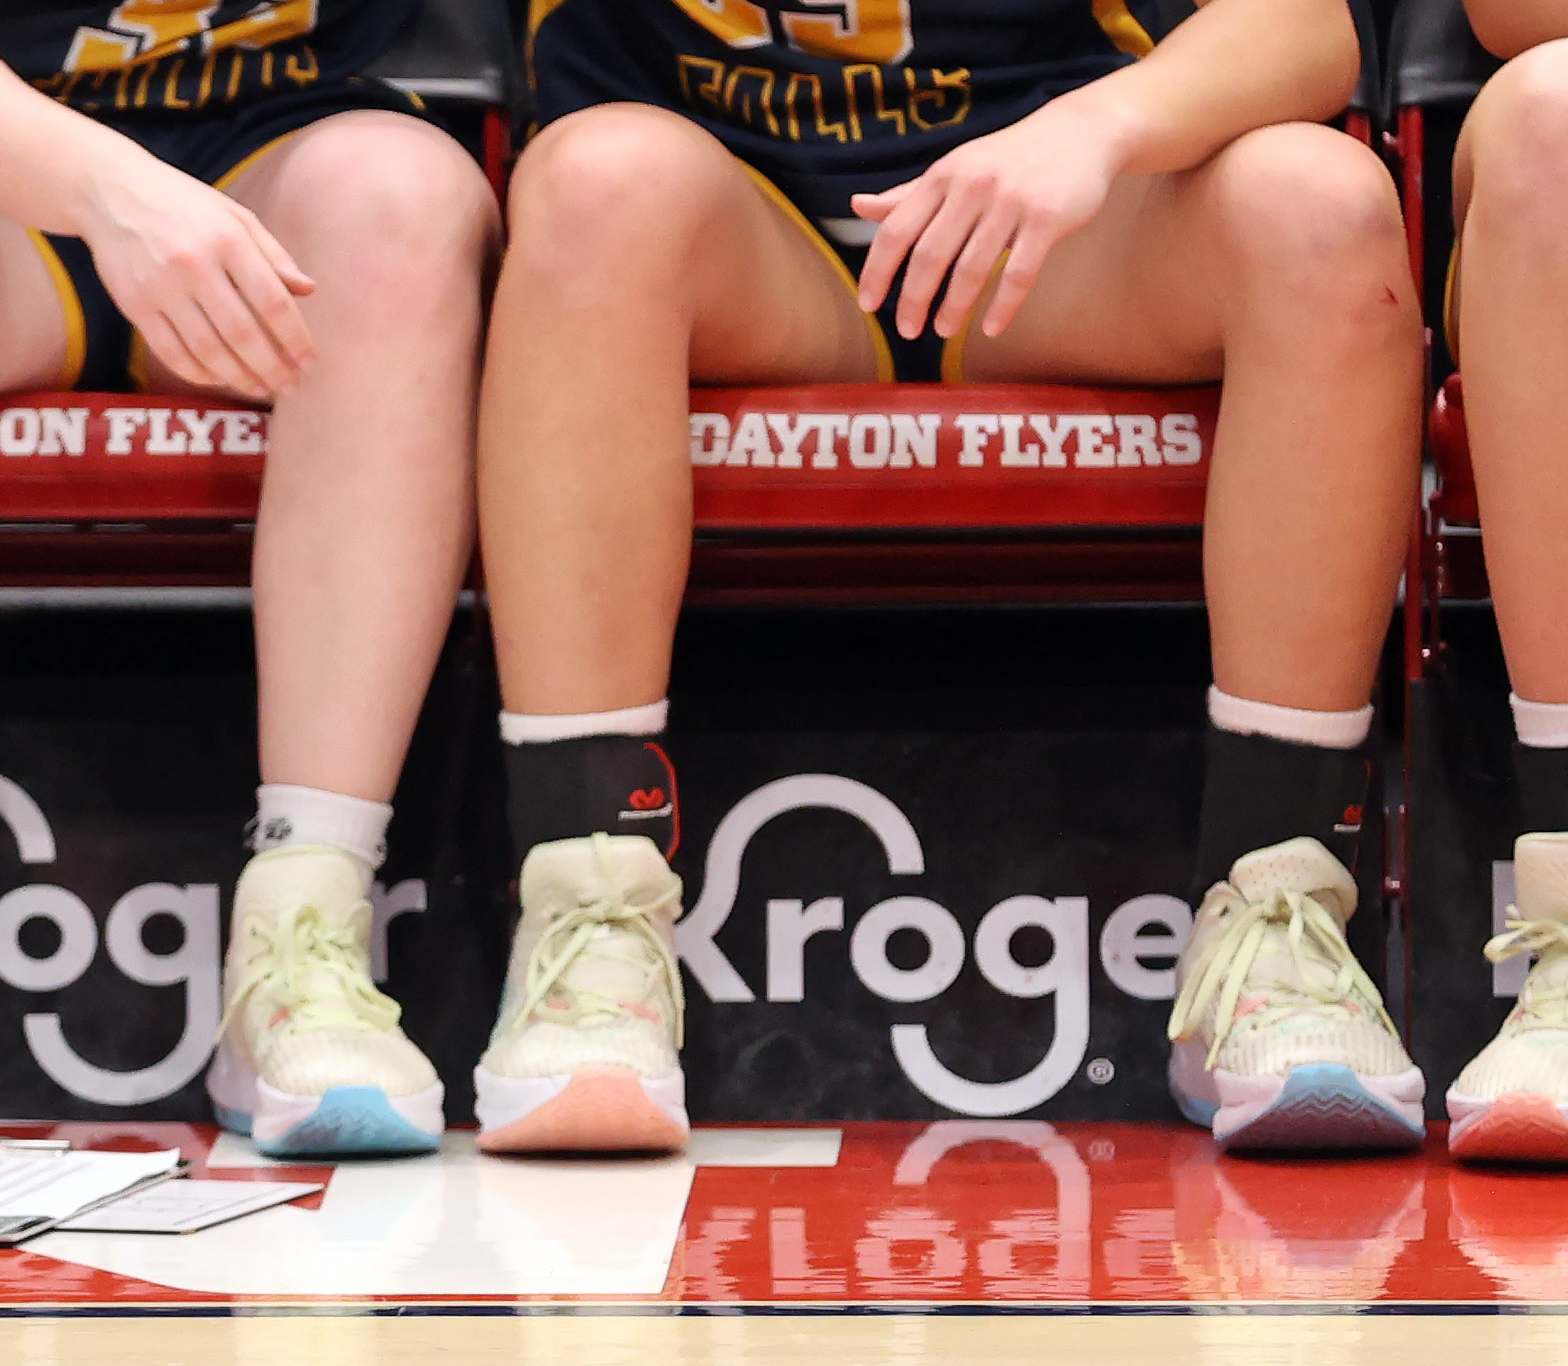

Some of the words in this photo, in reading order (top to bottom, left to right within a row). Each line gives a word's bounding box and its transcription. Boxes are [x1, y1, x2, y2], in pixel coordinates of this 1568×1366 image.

[102, 407, 274, 456] FLYE
[689, 412, 941, 469] DAYTON
[955, 413, 1203, 467] FLYERS
[677, 772, 1194, 1117] Kroge
